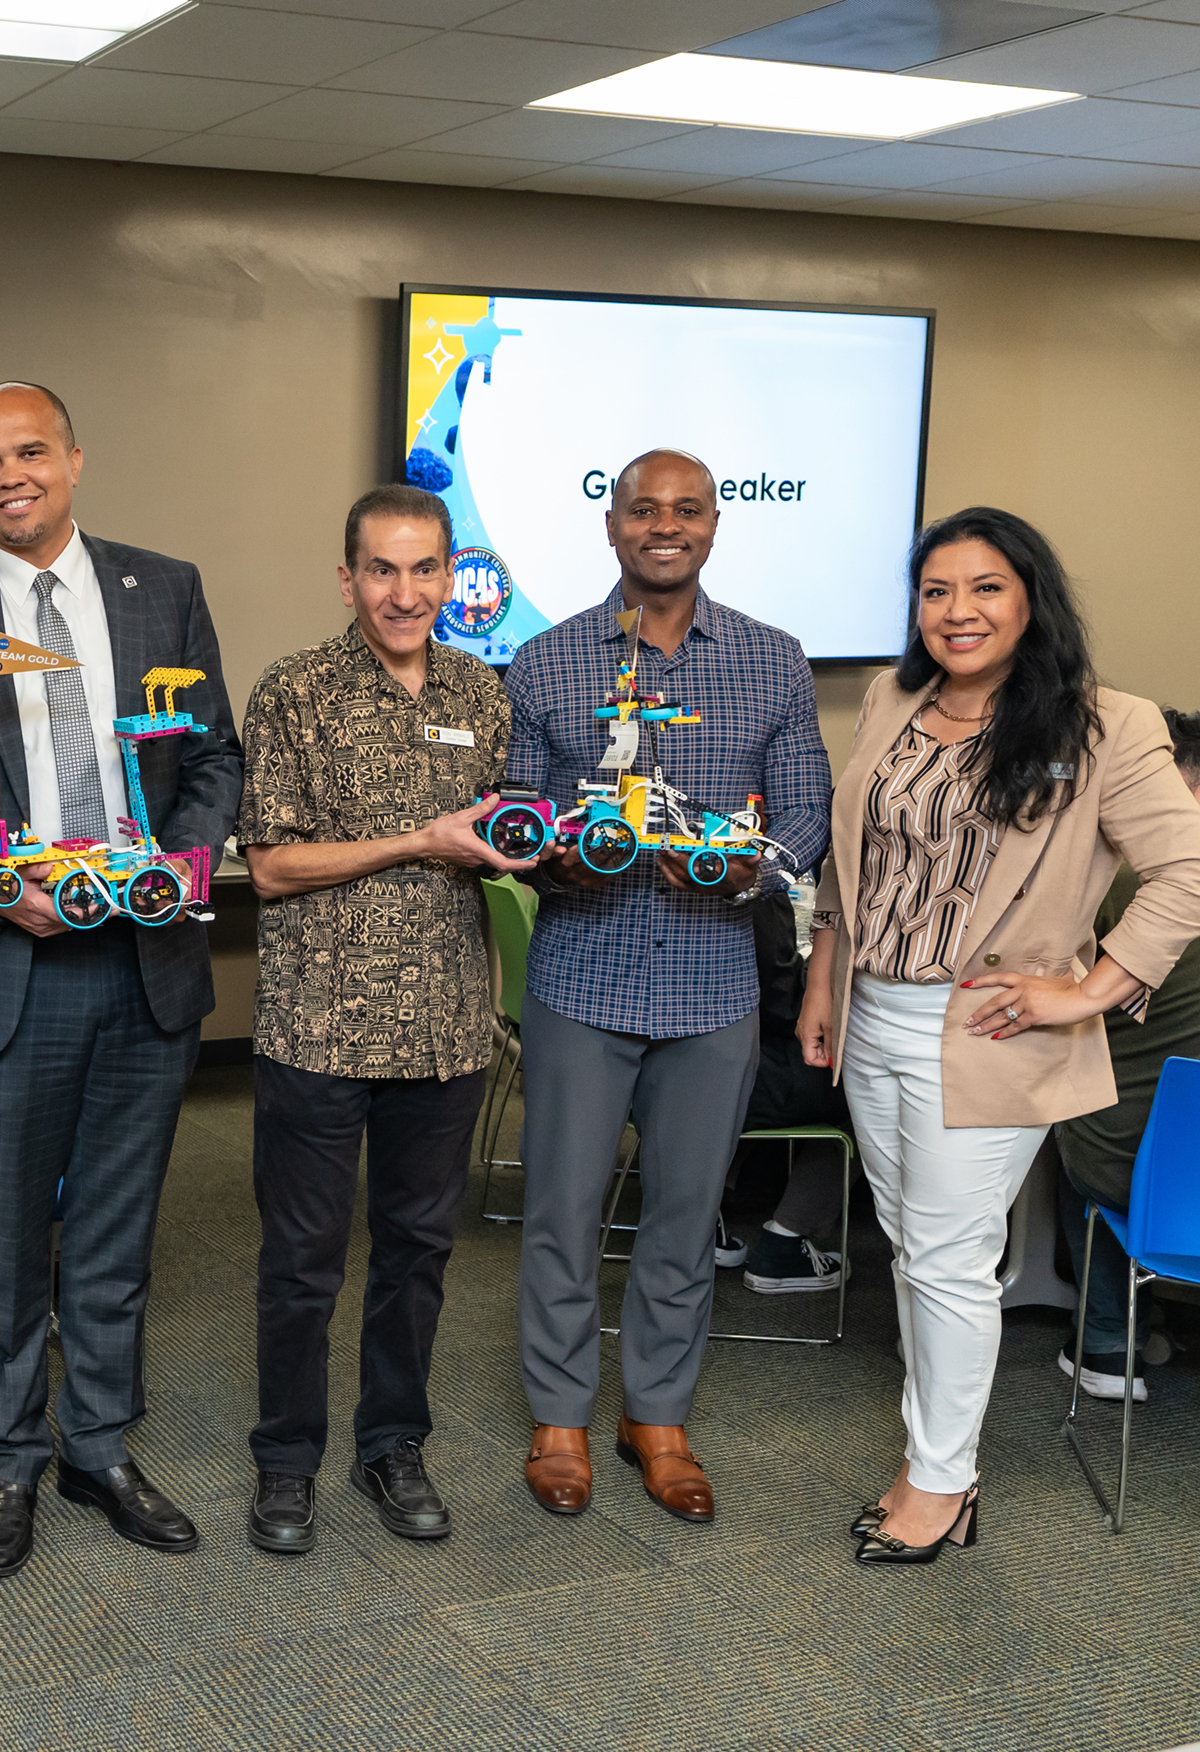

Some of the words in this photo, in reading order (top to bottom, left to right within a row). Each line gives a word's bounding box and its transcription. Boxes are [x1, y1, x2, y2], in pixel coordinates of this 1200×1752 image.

[714, 472, 806, 501] eaker
[455, 551, 490, 565] OMMUNITY
[491, 559, 509, 588] COLLEGE
[452, 566, 499, 606] NCAS
[441, 604, 474, 634] AEROSPACE
[476, 605, 506, 633] SCHOLARS
[27, 654, 59, 666] GOLD
